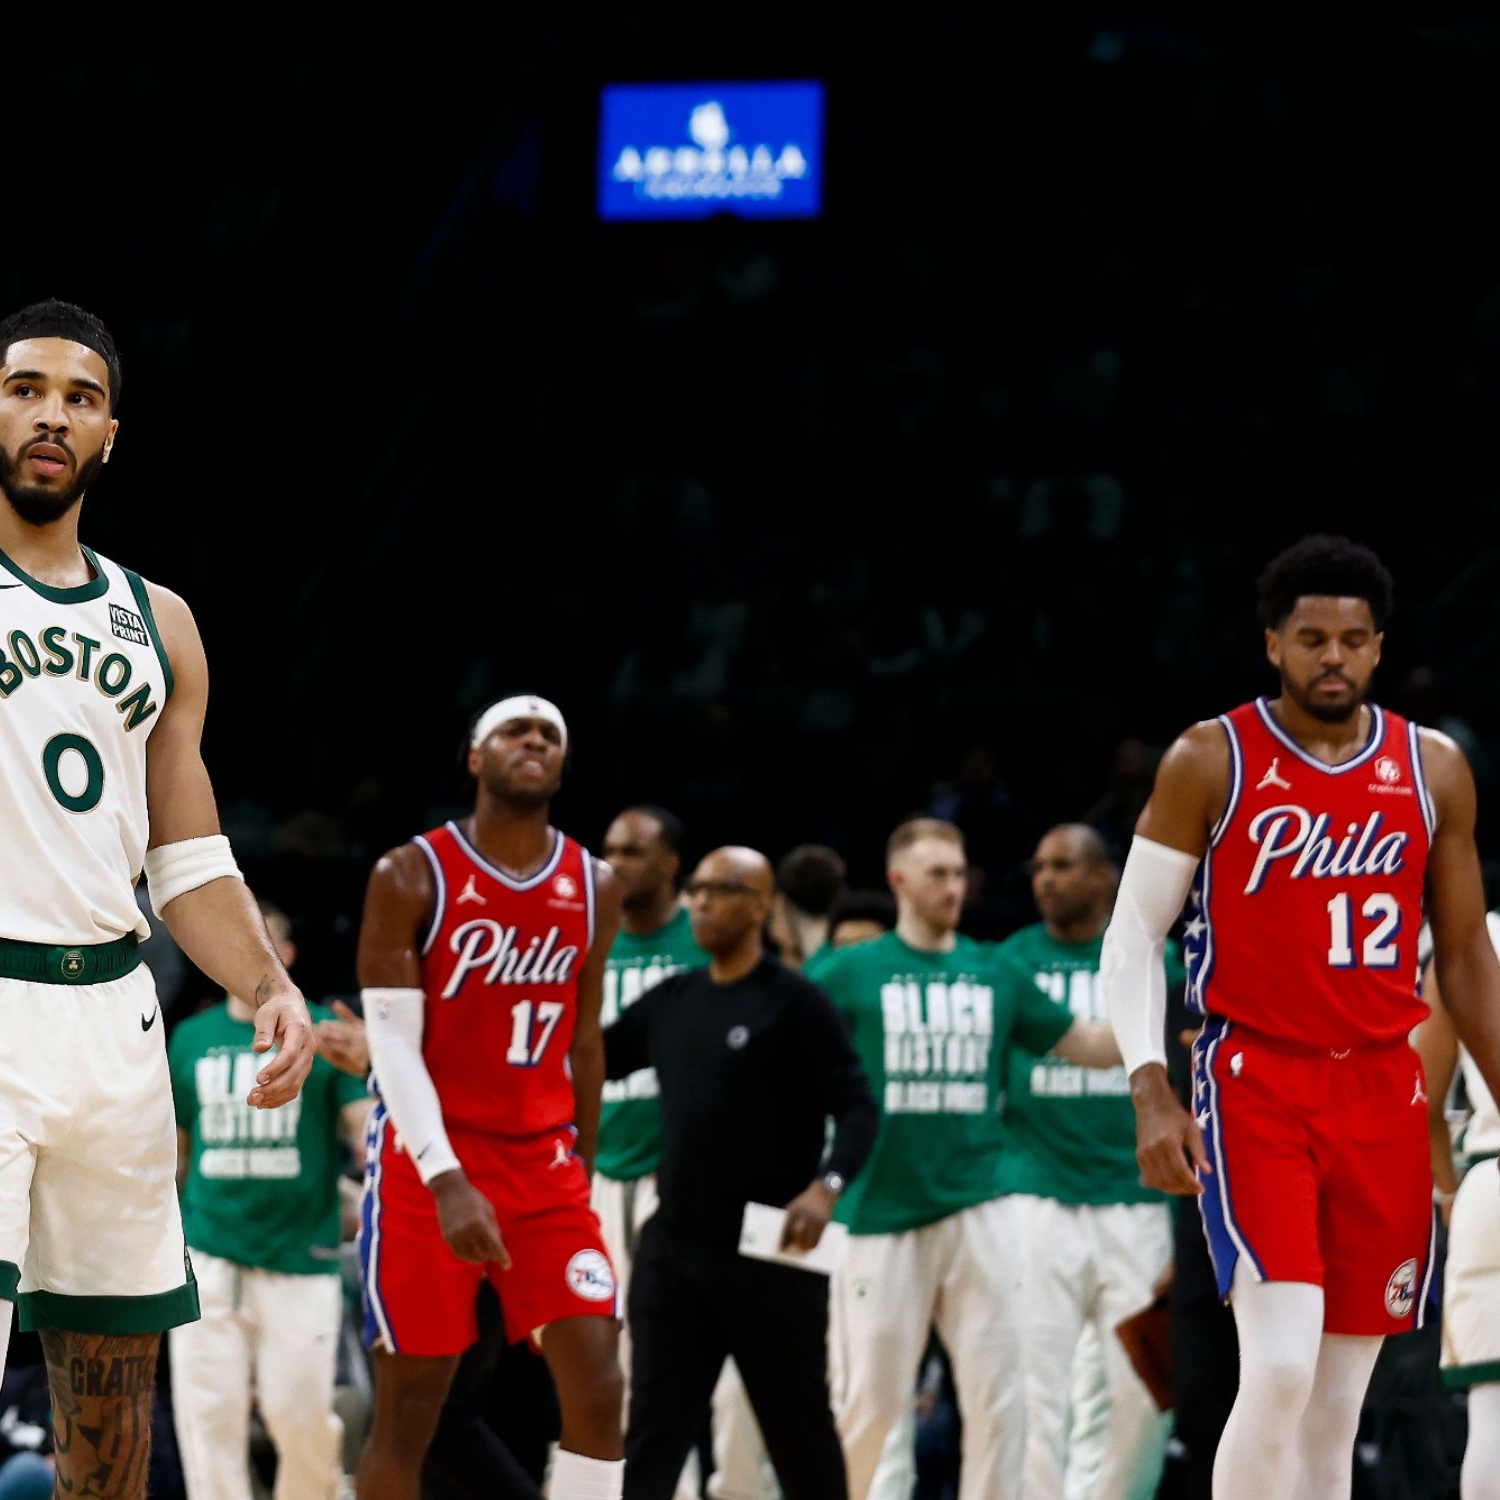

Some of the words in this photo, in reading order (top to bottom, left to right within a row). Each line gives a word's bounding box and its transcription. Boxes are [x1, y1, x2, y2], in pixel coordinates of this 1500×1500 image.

[109, 605, 145, 632] VISTA
[112, 622, 146, 645] PRINT
[41, 732, 105, 814] 0
[1243, 804, 1409, 895] Phila
[441, 918, 579, 999] Phila
[1327, 892, 1402, 969] 12
[506, 1000, 565, 1066] 17
[881, 981, 994, 1034] BLACK
